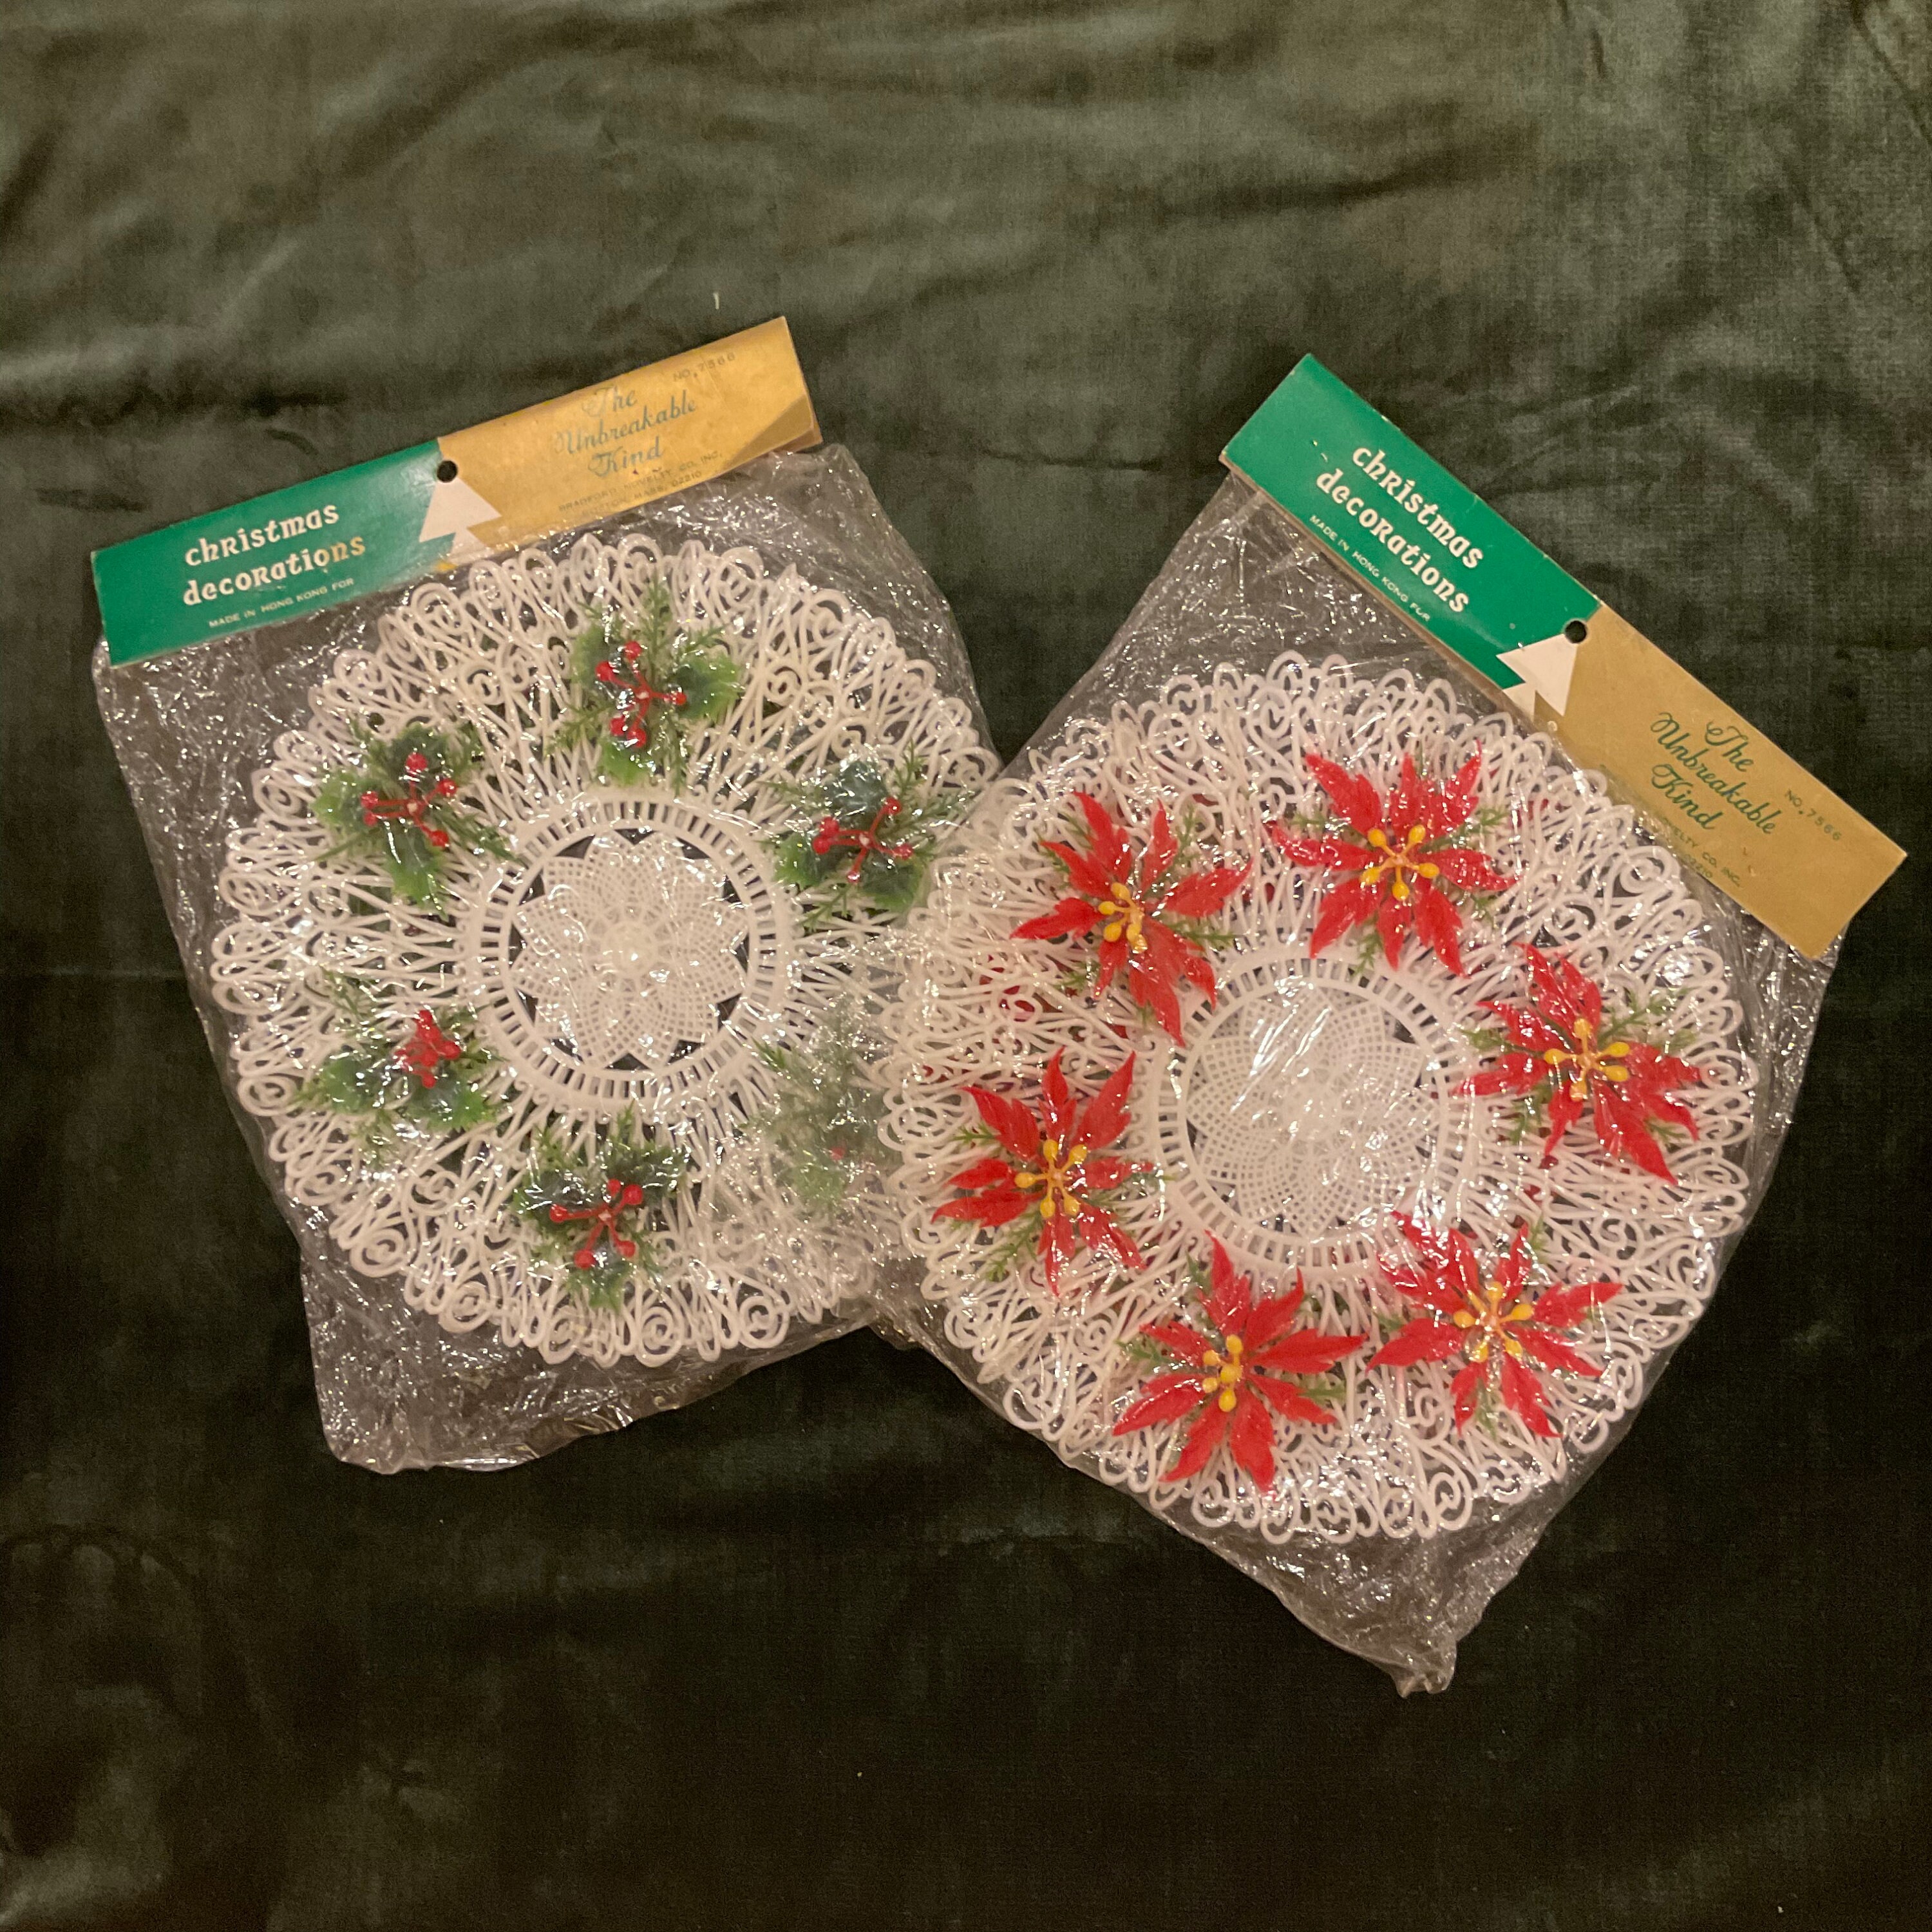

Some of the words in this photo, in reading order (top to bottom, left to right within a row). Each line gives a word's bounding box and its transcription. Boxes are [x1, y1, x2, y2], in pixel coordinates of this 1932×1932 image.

[554, 390, 696, 454] Unbreakable
[582, 385, 638, 417] The
[588, 436, 664, 477] Kind
[184, 504, 339, 566] christmas
[1316, 469, 1470, 612] decorations
[1352, 447, 1484, 569] christmas
[183, 536, 366, 605] decorations
[1309, 515, 1338, 541] MADE
[1338, 539, 1350, 551] IN
[1352, 551, 1380, 577] HONG
[1382, 576, 1408, 602] KONG
[209, 613, 240, 628] MADE
[243, 610, 256, 618] IN
[261, 598, 294, 612] HONG
[296, 586, 327, 601] KONG
[332, 578, 354, 591] FOR
[1651, 712, 1782, 835] Unbreakable
[1704, 720, 1754, 772] The
[1651, 764, 1724, 830] Kind
